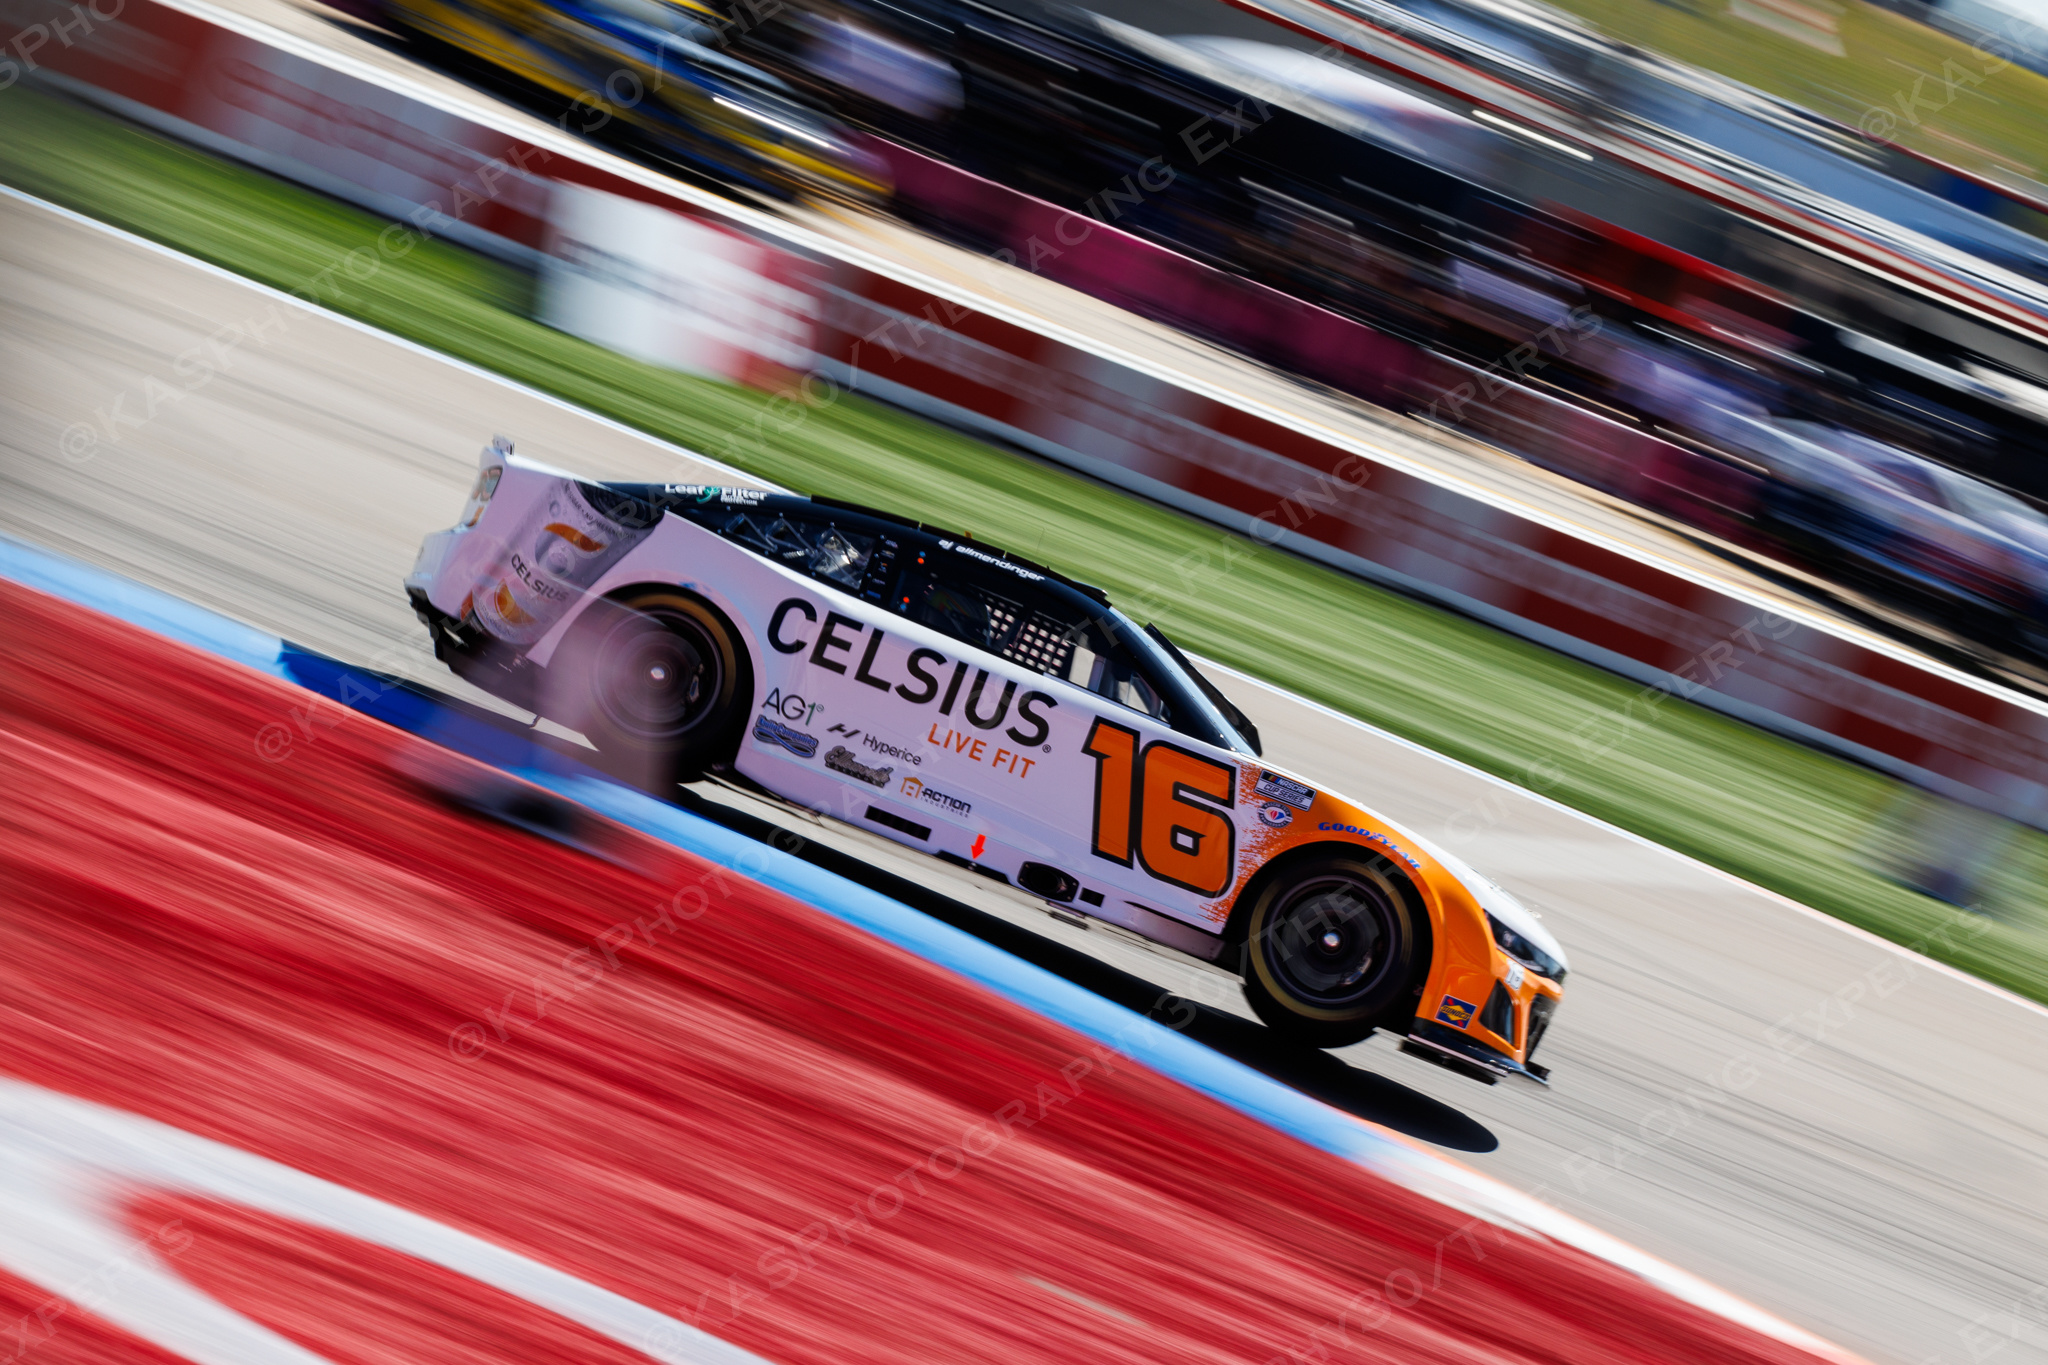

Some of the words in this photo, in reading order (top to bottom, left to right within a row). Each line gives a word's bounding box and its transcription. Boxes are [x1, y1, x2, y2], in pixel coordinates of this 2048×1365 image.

[511, 553, 570, 601] CELSIUS
[767, 597, 1058, 748] CELSIUS
[863, 733, 922, 766] Hyperice
[927, 722, 987, 762] LIVE
[991, 748, 1036, 779] FIT
[921, 786, 971, 814] ACTION
[1081, 715, 1237, 898] 16
[1264, 783, 1280, 793] CUP
[1279, 789, 1304, 803] SERIES
[1278, 779, 1308, 794] NASCAR
[1318, 822, 1421, 869] GOODYEAR
[1441, 1005, 1471, 1020] SUNOCO
